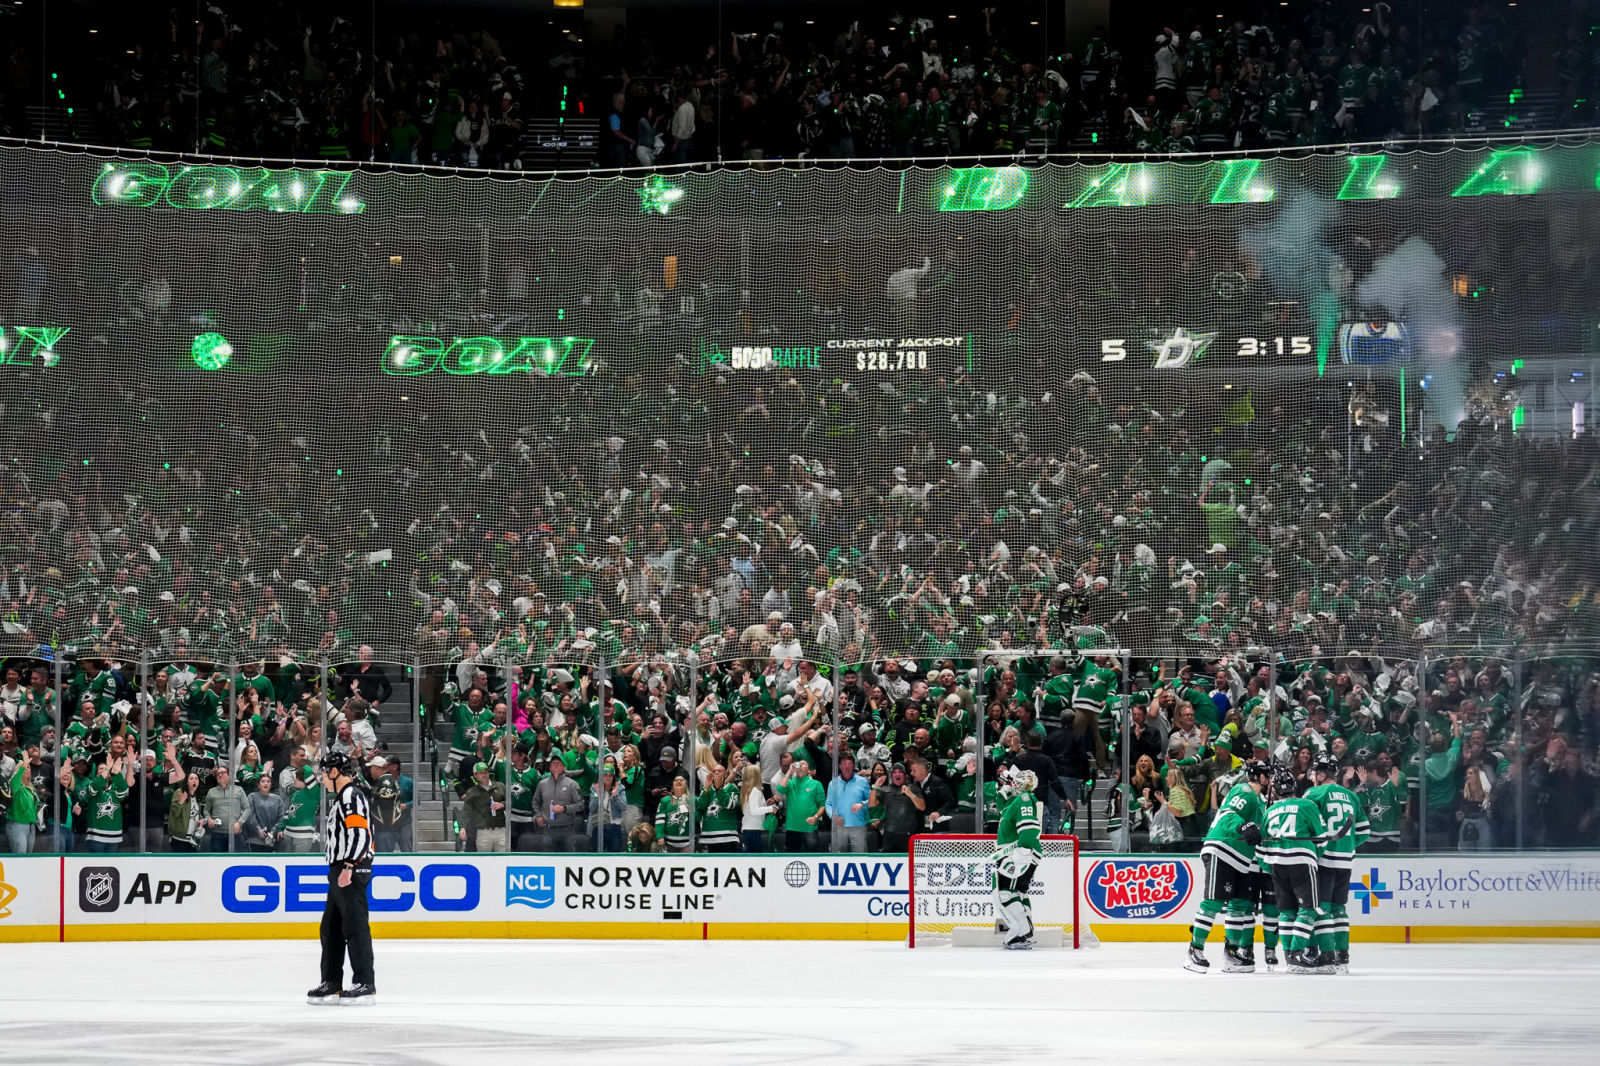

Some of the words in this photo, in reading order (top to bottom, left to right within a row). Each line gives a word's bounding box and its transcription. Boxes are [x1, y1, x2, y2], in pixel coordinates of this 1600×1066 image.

[92, 162, 366, 214] GOAL
[938, 146, 1600, 211] DALLA
[826, 338, 894, 349] CURRENT
[896, 336, 963, 348] JACKPOT
[1101, 339, 1127, 362] 5
[1237, 336, 1312, 358] 3:15
[381, 335, 595, 376] GOAL
[773, 346, 821, 368] RAFFLE
[1020, 806, 1034, 817] 29
[508, 873, 552, 892] NCL
[565, 866, 766, 889] NORWEGIAN
[818, 862, 905, 888] NAVY
[913, 862, 1045, 888] FEDER
[1099, 862, 1177, 886] Jersey
[222, 864, 480, 912] GECO
[1105, 880, 1179, 909] Mike's
[565, 893, 652, 910] CRUISE
[936, 896, 995, 918] Union
[1127, 906, 1157, 918] SUBS
[1399, 899, 1471, 910] HEALTH
